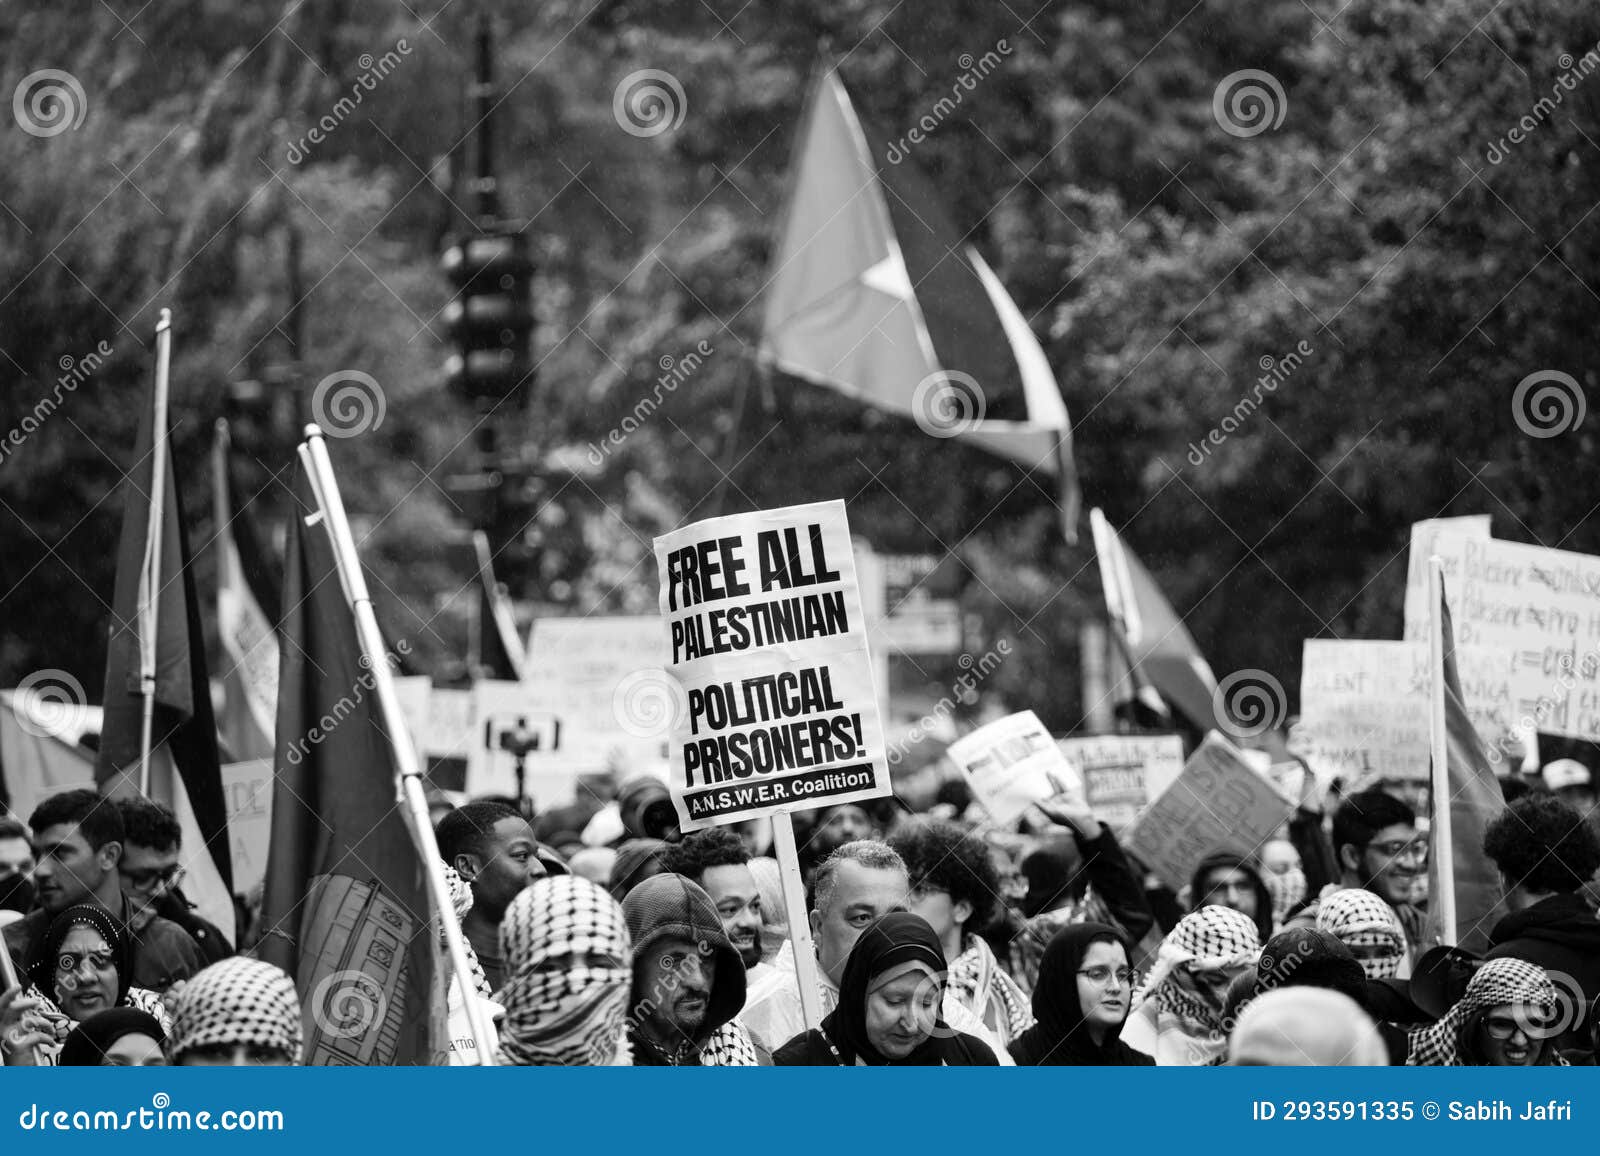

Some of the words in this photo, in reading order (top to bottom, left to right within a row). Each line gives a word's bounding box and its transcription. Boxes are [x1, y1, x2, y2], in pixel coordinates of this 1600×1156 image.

[667, 535, 751, 612] FREE
[758, 523, 841, 592] ALL
[671, 590, 849, 665] PALESTINIAN
[688, 665, 844, 735] POLITICAL
[684, 713, 867, 788] PRISONERS!
[691, 782, 790, 814] A.N.S.W.E.R.
[791, 770, 871, 796] Coalition
